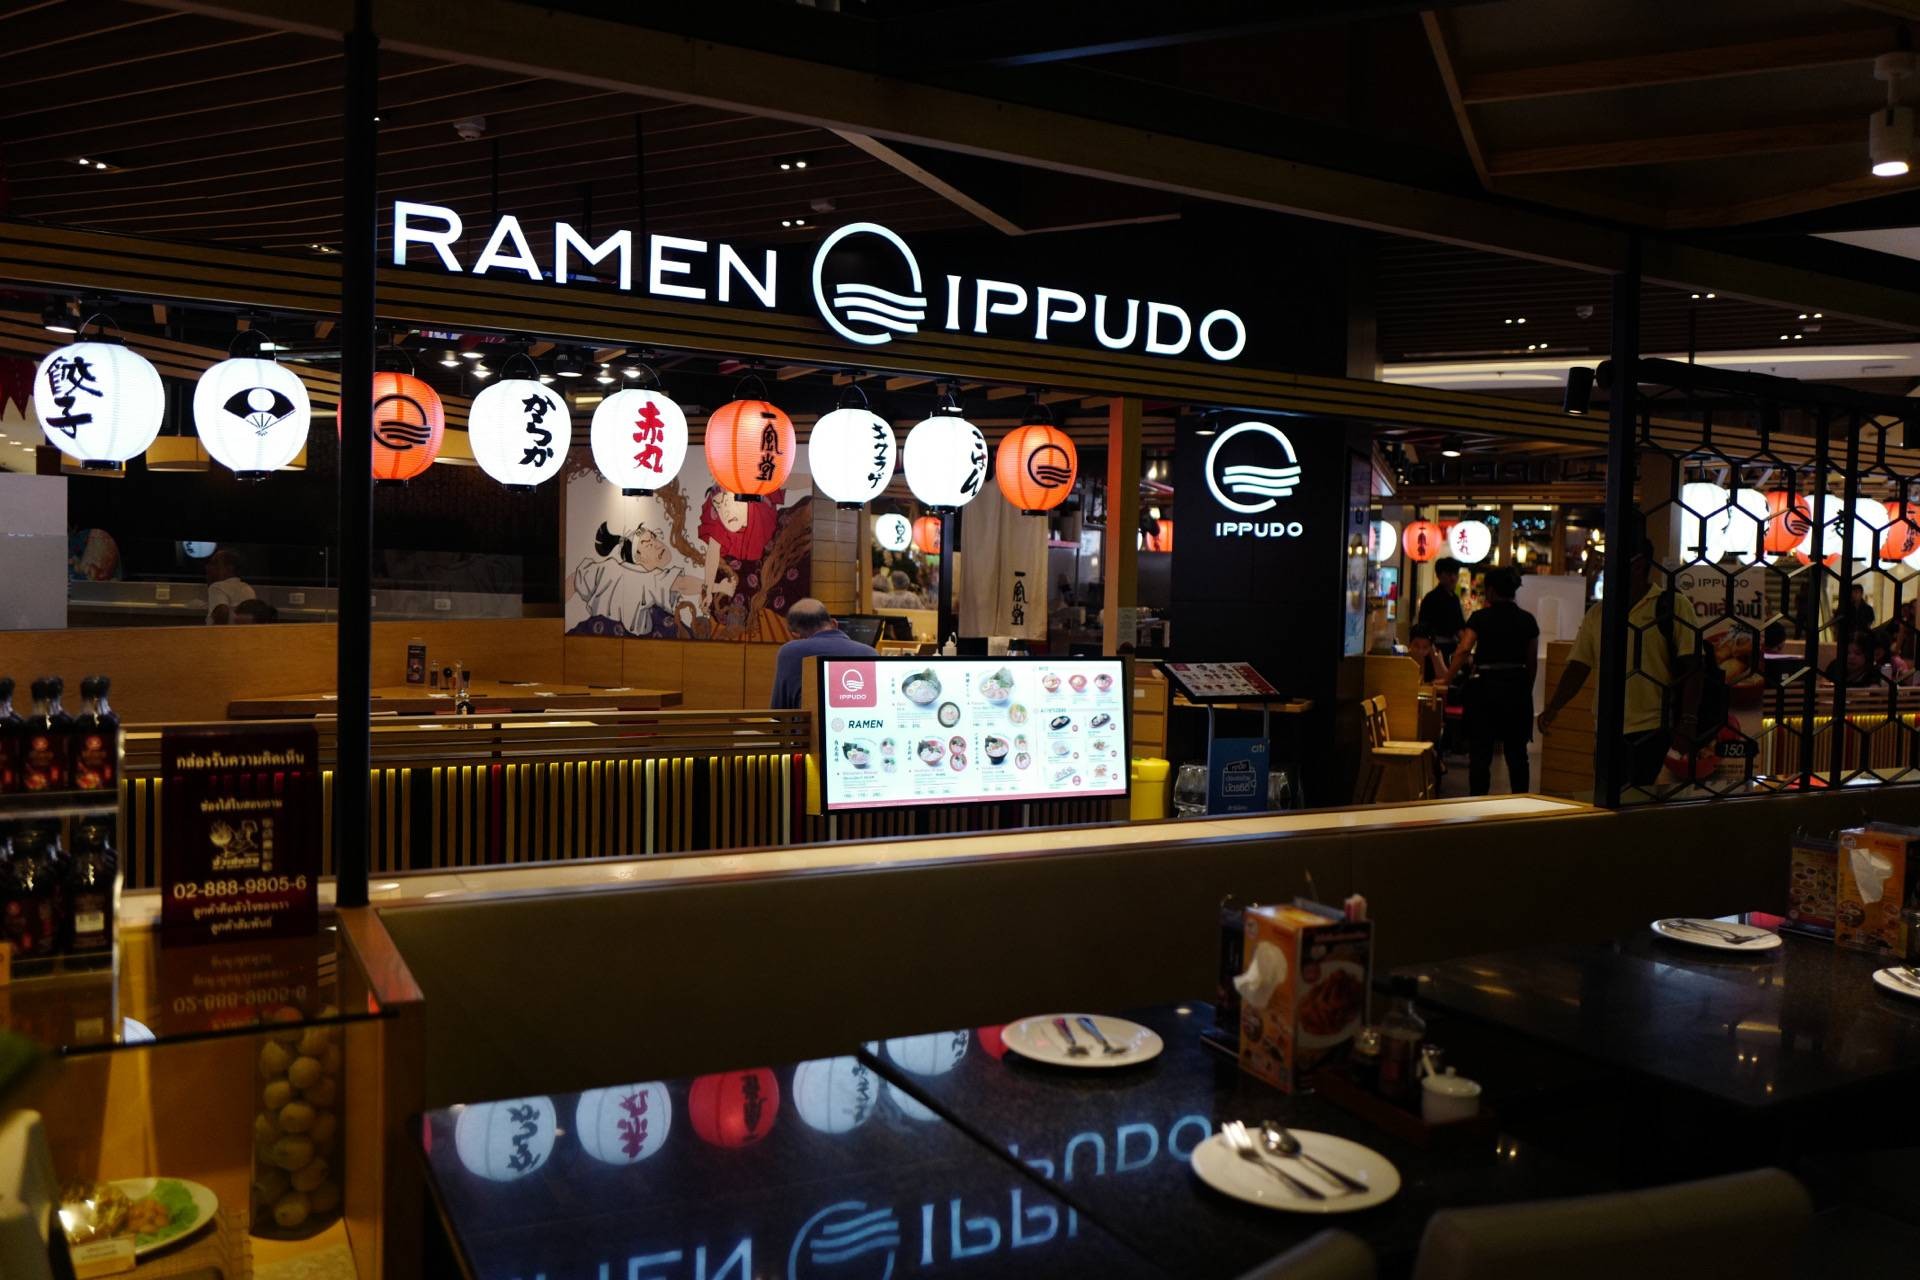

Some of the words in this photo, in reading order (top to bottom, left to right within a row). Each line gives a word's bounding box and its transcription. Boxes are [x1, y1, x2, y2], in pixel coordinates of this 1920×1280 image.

[393, 200, 777, 308] RAMEN
[945, 274, 1247, 361] IPPUDO
[45, 356, 104, 439] 餃子
[633, 401, 664, 473] 赤丸
[756, 412, 783, 481] 一風堂
[1215, 521, 1303, 538] IPPUDO
[848, 720, 884, 729] RAMEN
[1251, 744, 1265, 753] citi
[173, 874, 307, 899] 02-888-9805-6
